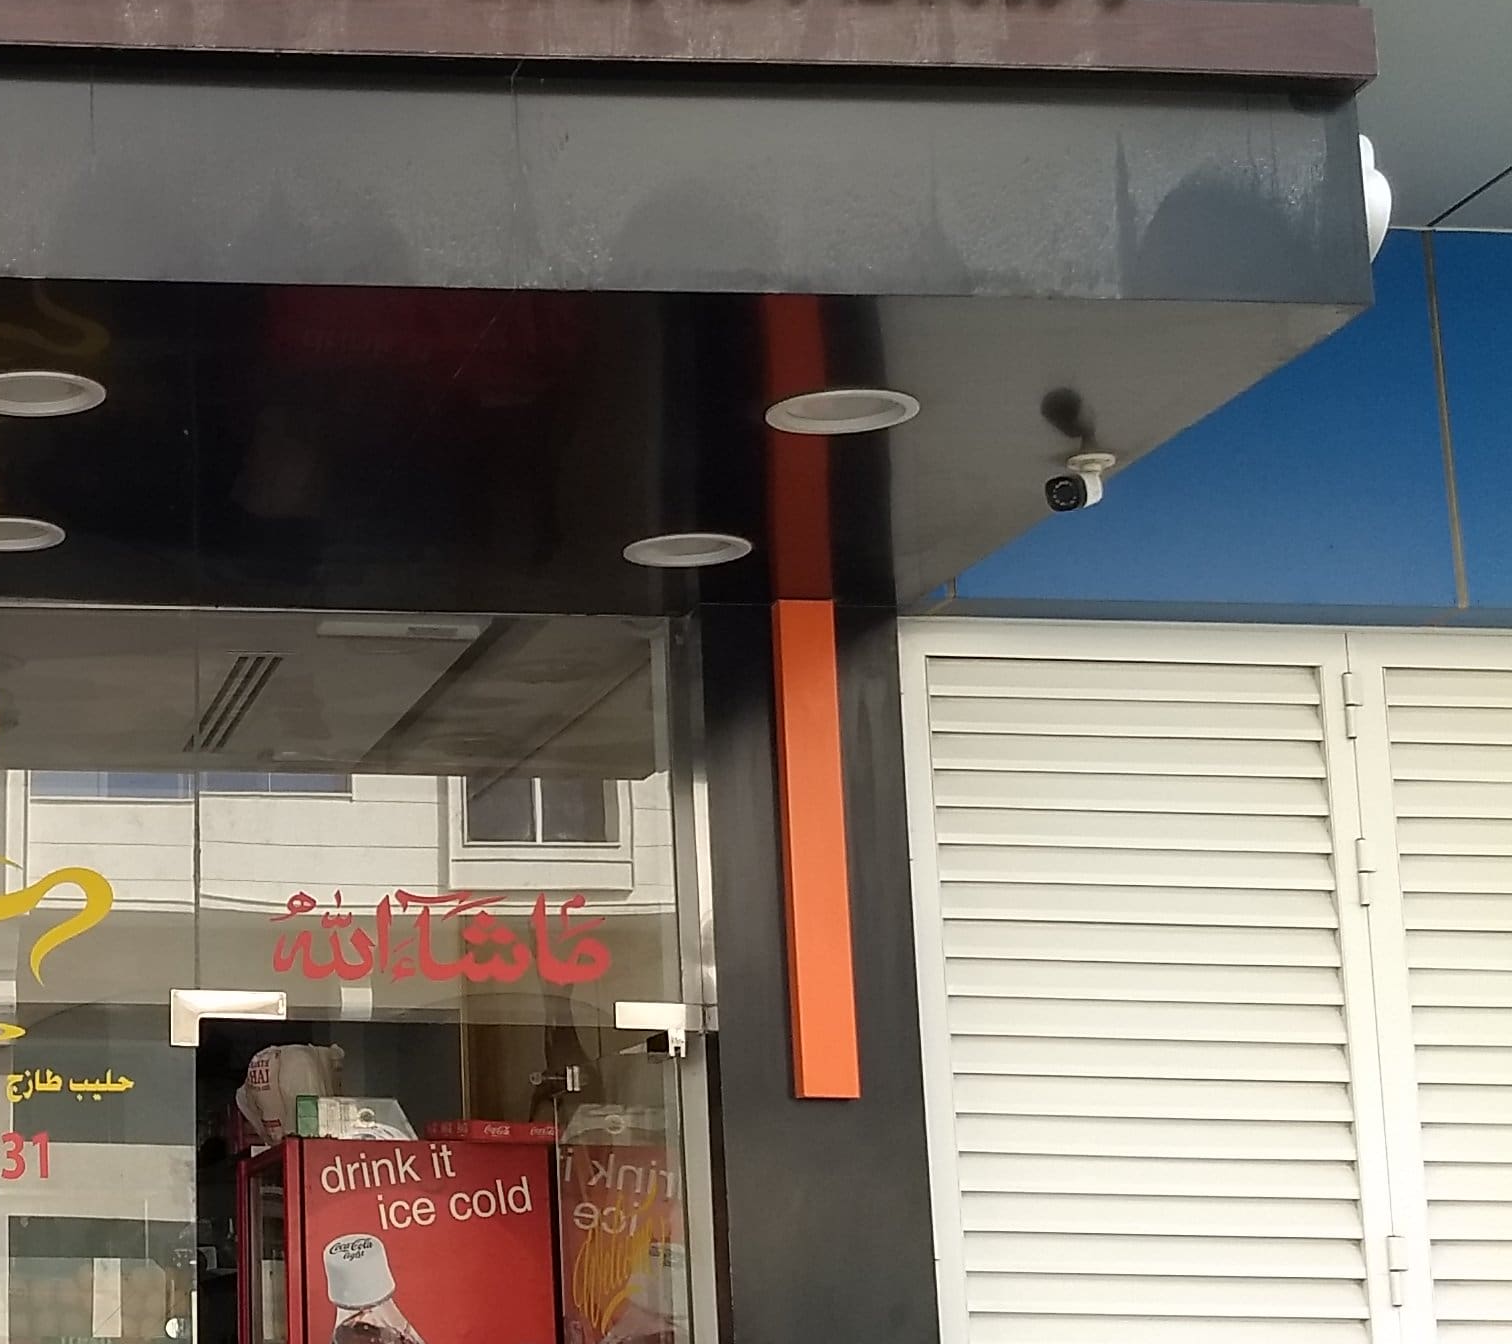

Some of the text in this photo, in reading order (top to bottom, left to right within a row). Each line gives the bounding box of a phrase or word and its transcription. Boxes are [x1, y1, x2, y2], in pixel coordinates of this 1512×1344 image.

[5, 1068, 135, 1104] حليب طازج
[320, 1143, 456, 1194] drink it
[377, 1176, 533, 1230] ice cold
